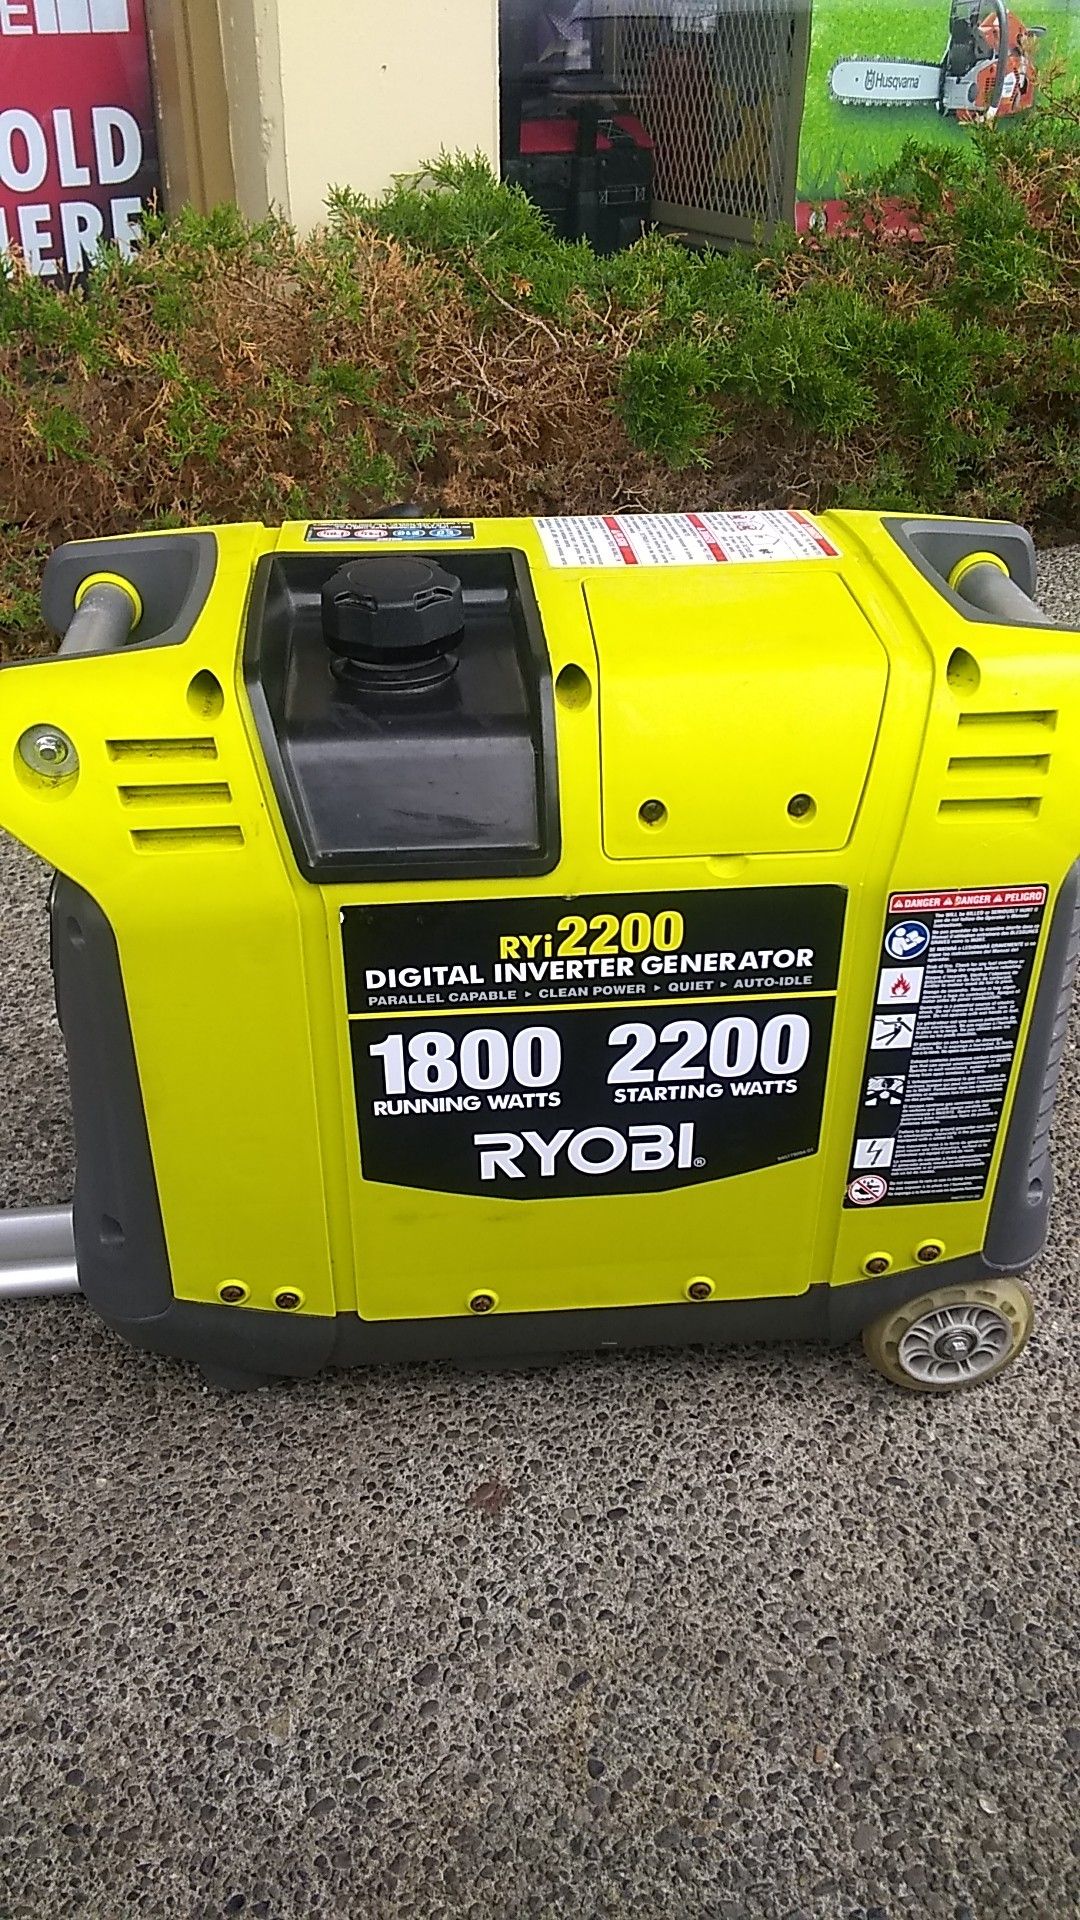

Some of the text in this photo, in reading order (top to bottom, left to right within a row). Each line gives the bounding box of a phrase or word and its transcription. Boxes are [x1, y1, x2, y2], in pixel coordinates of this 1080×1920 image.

[875, 72, 919, 91] Husqvarna
[904, 891, 1042, 908] DANGER DANGER PELIGRO
[499, 910, 684, 960] RYi2200
[365, 948, 814, 990] DIGITAL INVERTER GENERATOR
[368, 975, 813, 1006] PARALLEL CAPABLE CLEAN POWER QUIET AUTO-IDLE
[369, 1026, 562, 1095] 1800
[606, 1013, 810, 1085] 2200
[373, 1091, 561, 1116] RUNNING WATTS
[613, 1079, 798, 1104] STARTING WATTS
